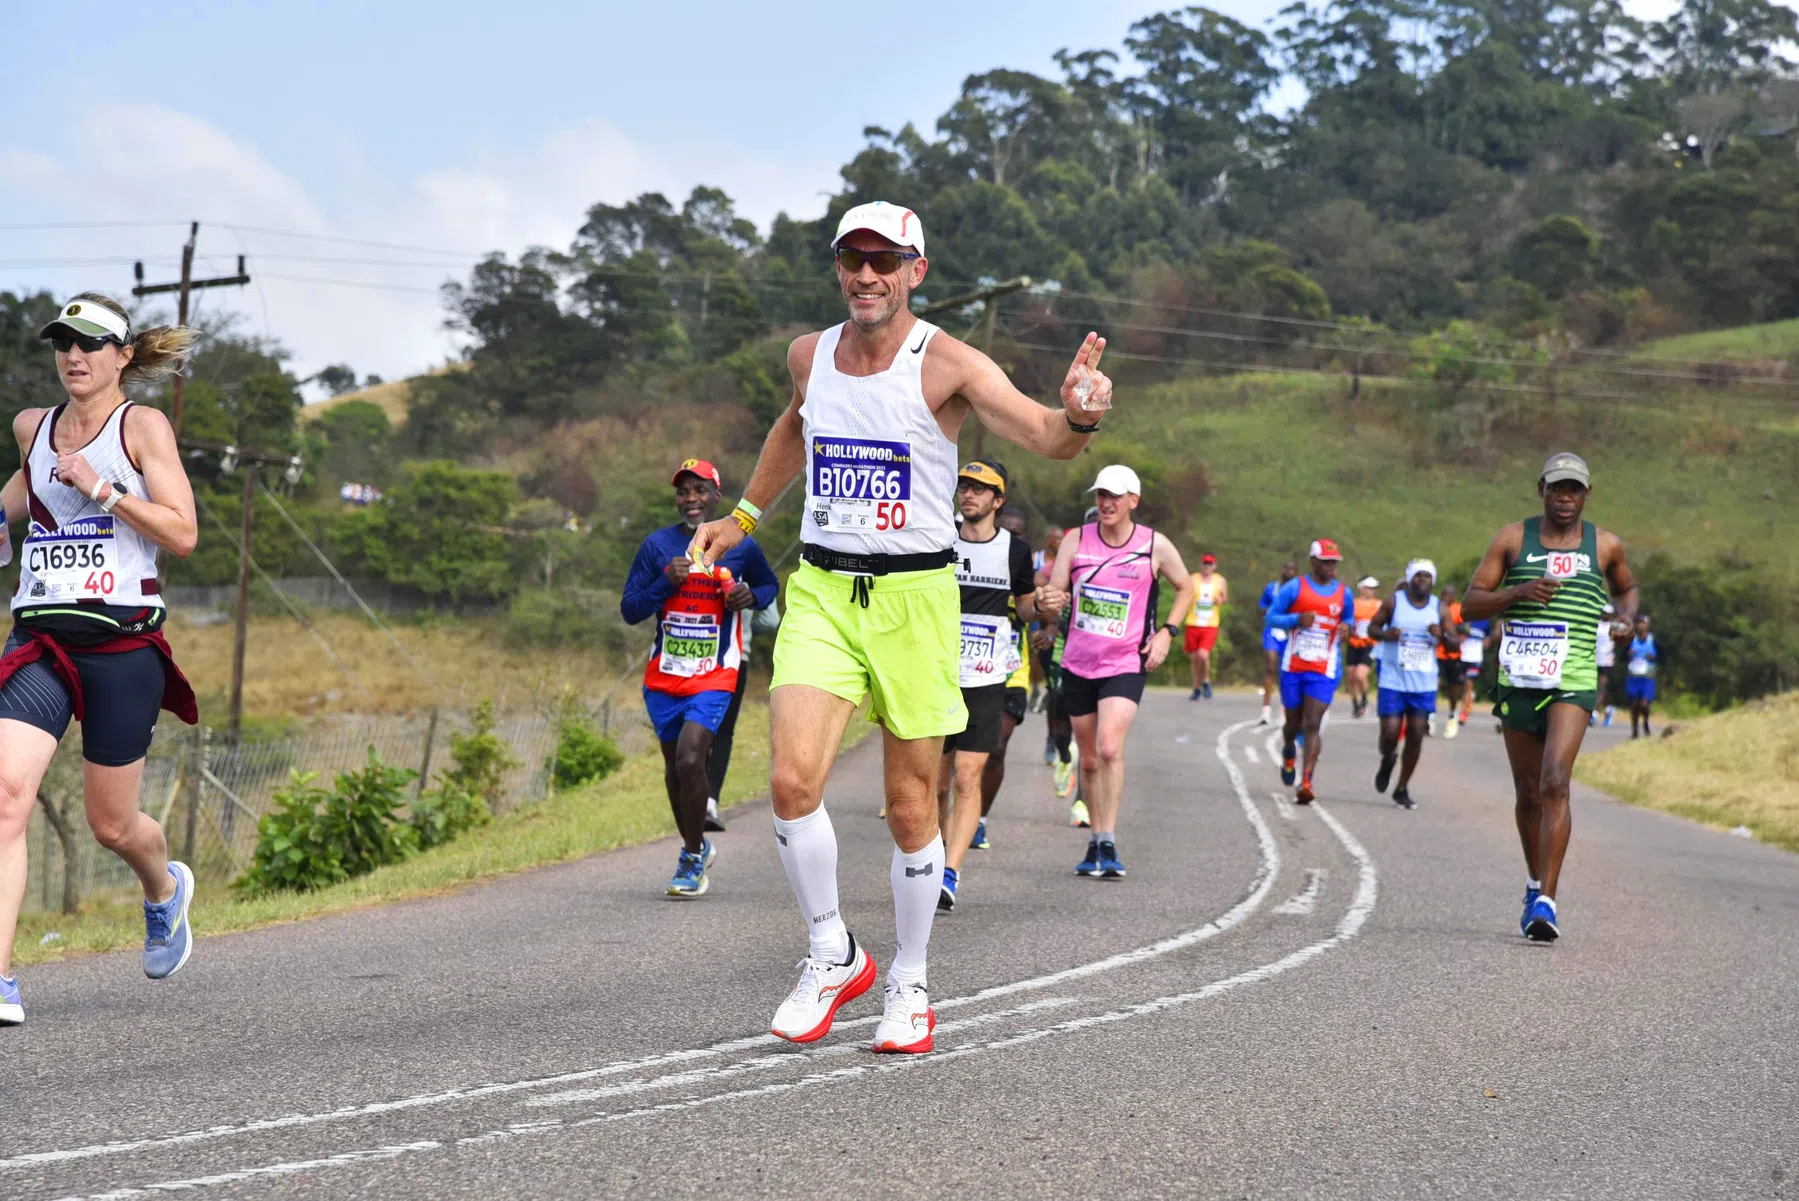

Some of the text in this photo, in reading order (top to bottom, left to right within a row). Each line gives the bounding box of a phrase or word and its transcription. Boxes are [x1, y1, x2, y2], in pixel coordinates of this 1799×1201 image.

[820, 467, 901, 499] B10766
[875, 502, 906, 530] 50
[30, 543, 105, 572] C16936
[1552, 556, 1572, 575] 50
[84, 571, 115, 595] 40
[1108, 621, 1124, 636] 40
[667, 639, 713, 658] C23437
[960, 639, 989, 657] 9737
[696, 658, 712, 672] 50
[975, 660, 994, 674] 40
[1538, 658, 1558, 676] 50
